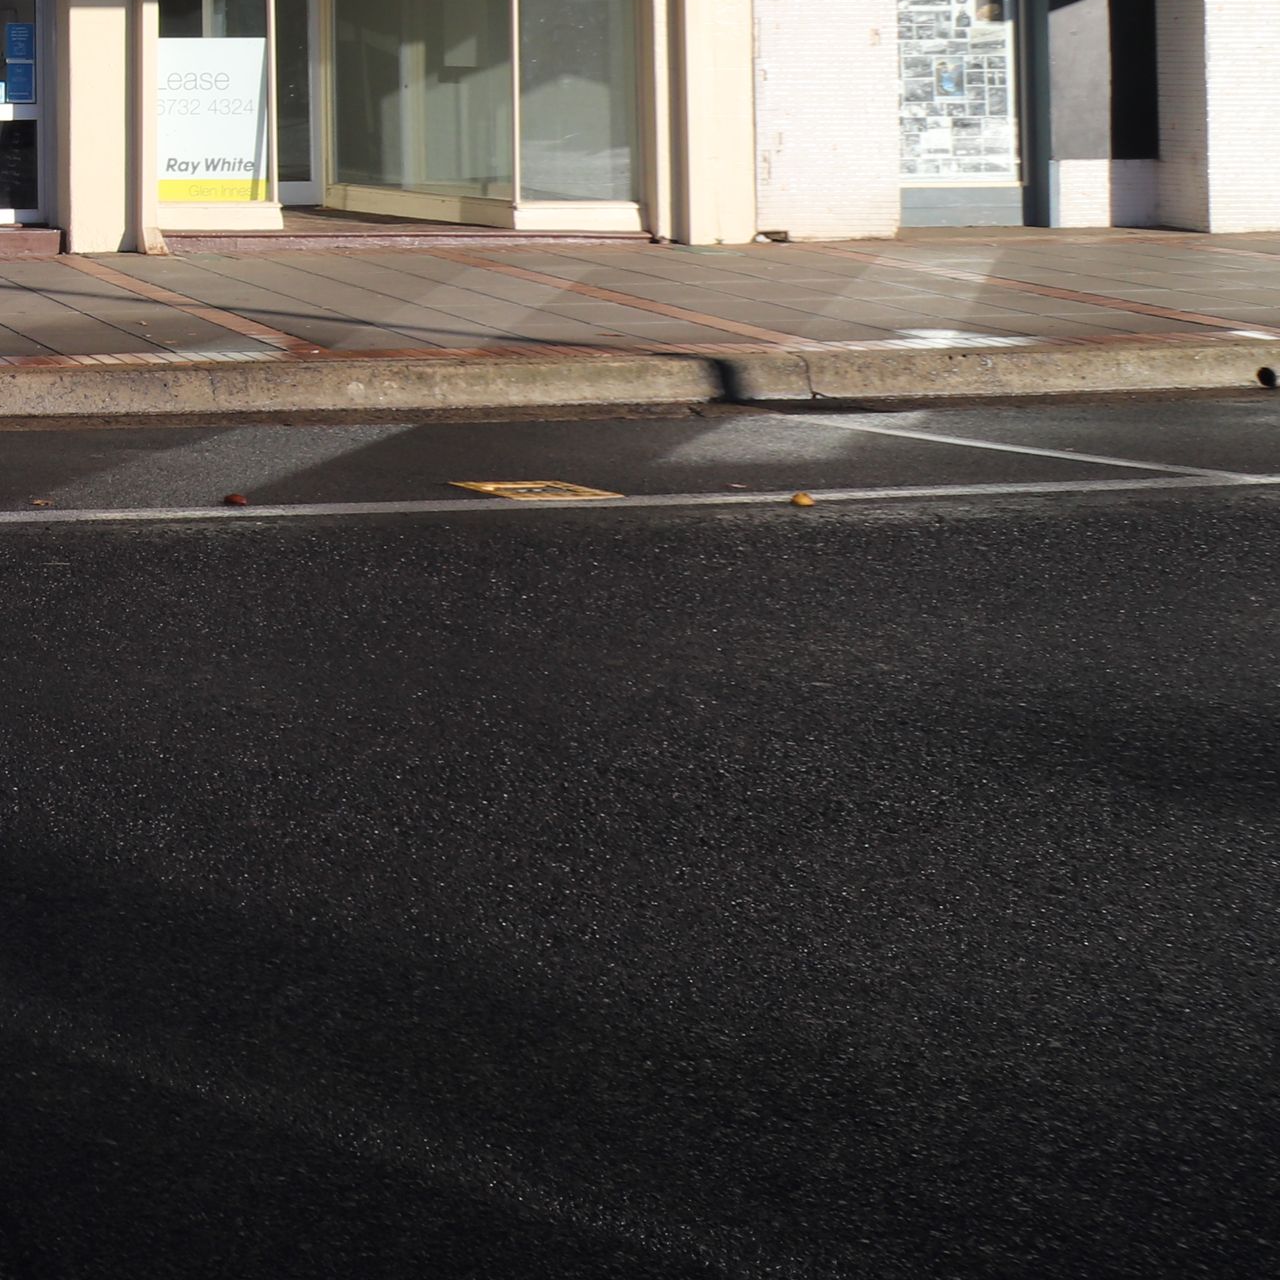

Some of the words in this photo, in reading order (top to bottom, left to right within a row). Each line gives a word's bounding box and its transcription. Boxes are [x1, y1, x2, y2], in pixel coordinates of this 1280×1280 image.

[207, 98, 254, 115] 4324
[166, 157, 201, 174] Ray
[204, 157, 255, 172] White
